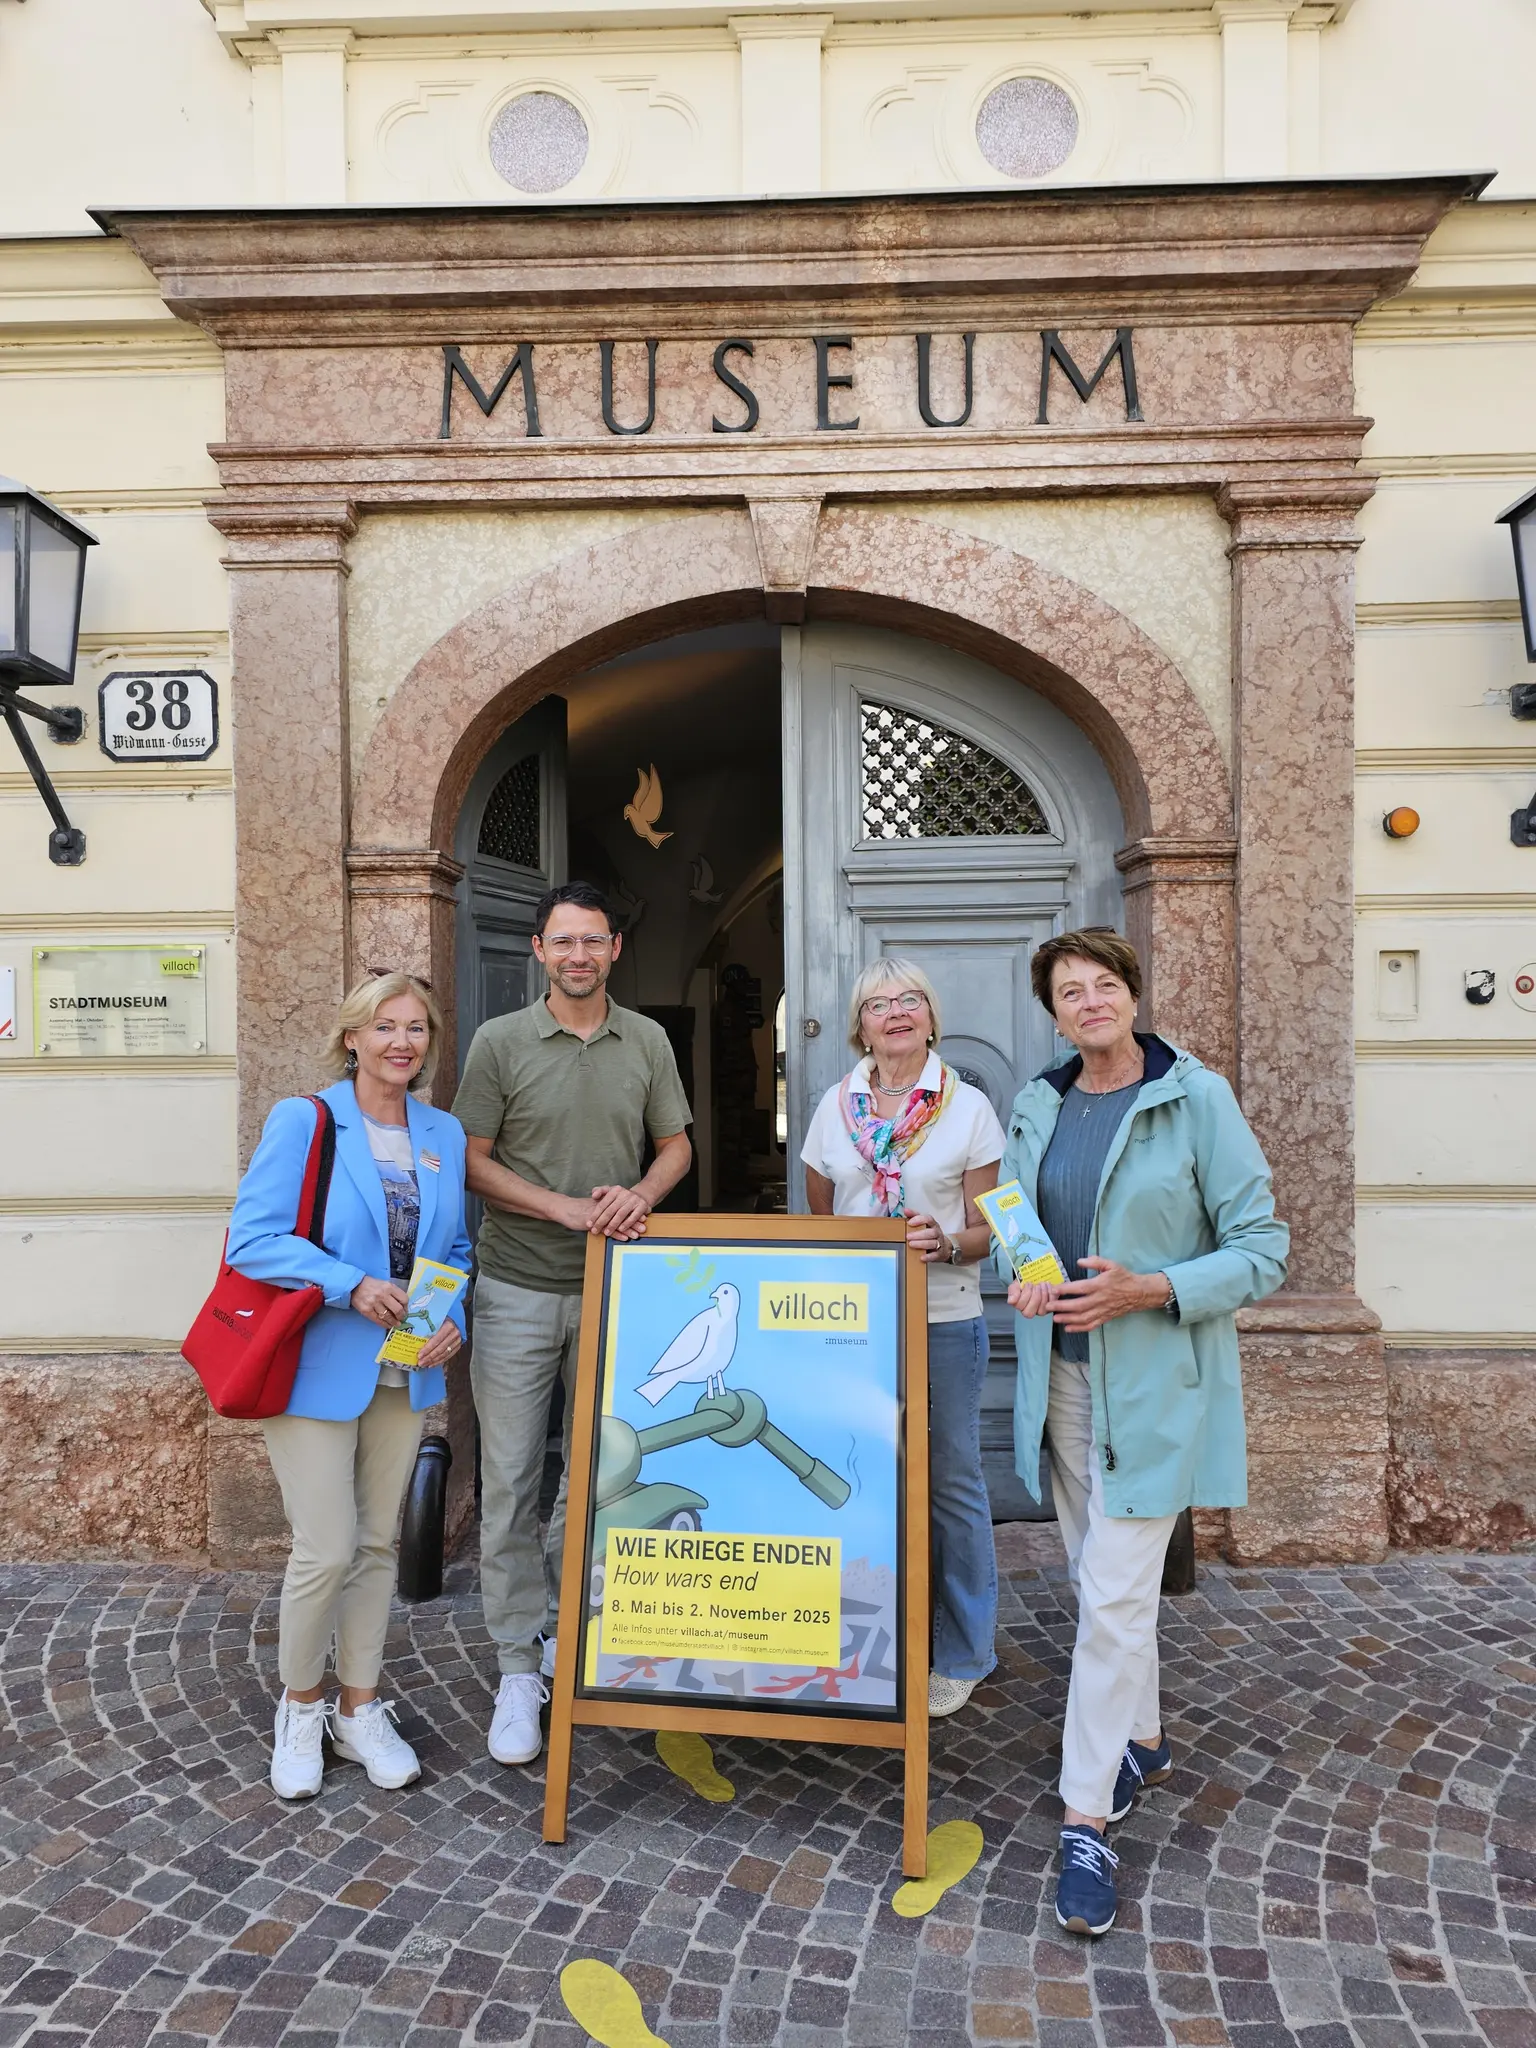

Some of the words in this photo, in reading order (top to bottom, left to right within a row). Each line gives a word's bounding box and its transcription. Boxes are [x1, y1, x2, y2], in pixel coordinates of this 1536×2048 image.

[437, 327, 1145, 439] MUSEUM
[126, 680, 191, 731] 38
[162, 960, 196, 971] villach
[49, 996, 167, 1009] STADTMUSEUM
[434, 1279, 456, 1290] villach
[769, 1292, 858, 1321] villach
[615, 1536, 657, 1558] WIE
[664, 1538, 745, 1562] KRIEGE
[753, 1542, 832, 1567] ENDEN
[613, 1564, 659, 1586] How
[666, 1571, 712, 1589] wars
[719, 1571, 759, 1591] end
[612, 1599, 625, 1613] 8.
[631, 1600, 656, 1615] Mai
[662, 1601, 684, 1616] bis
[690, 1603, 703, 1617] 2.
[710, 1605, 788, 1622] November
[793, 1609, 831, 1624] 2025
[612, 1623, 629, 1633] Alle
[631, 1624, 653, 1634] Infos
[655, 1627, 678, 1636] unter
[681, 1627, 769, 1641] villach.at/museum
